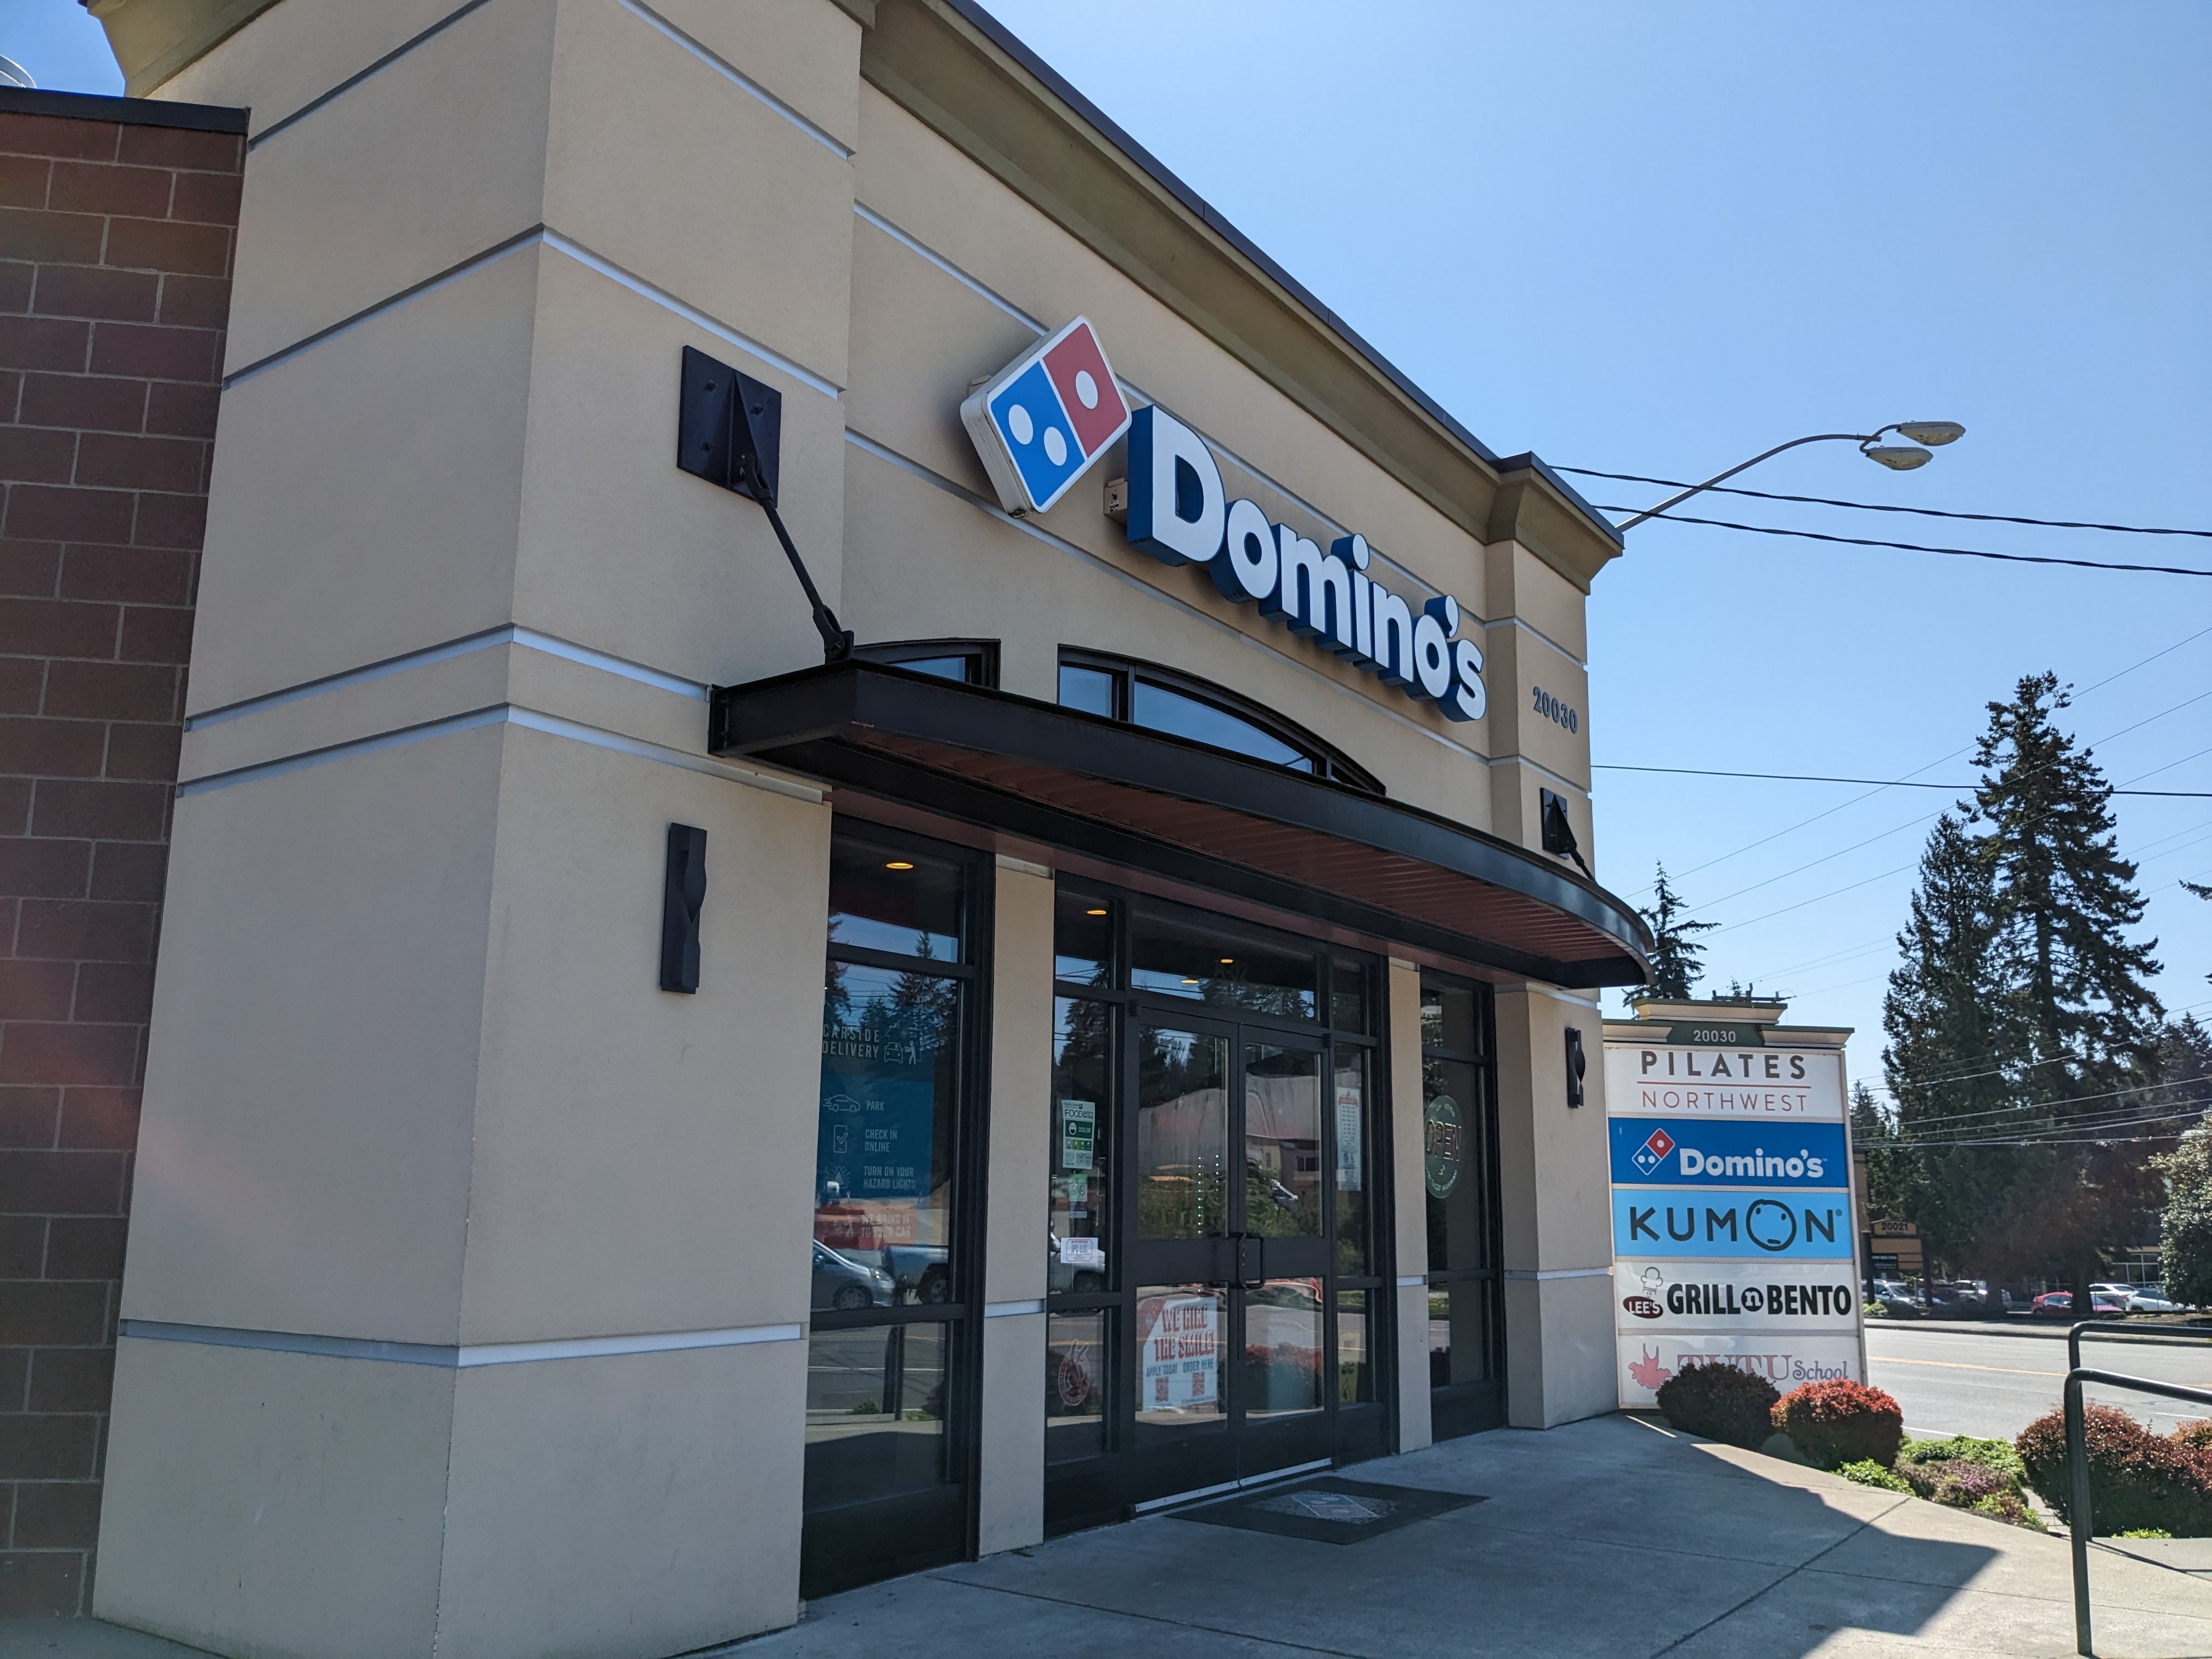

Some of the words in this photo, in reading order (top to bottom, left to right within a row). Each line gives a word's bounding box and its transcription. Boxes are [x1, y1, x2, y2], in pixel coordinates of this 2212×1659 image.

[1127, 404, 1486, 722] Domino's
[1533, 686, 1578, 734] 20030
[823, 1024, 879, 1042] CARSIDE
[1693, 1029, 1736, 1043] 20030
[822, 1040, 879, 1058] DELIVERY
[1640, 1050, 1805, 1080] PILATES
[866, 1100, 885, 1111] PARK
[1642, 1090, 1807, 1111] NORTHWEST
[1065, 1109, 1083, 1118] FOOD
[865, 1128, 888, 1139] CHECK
[890, 1130, 898, 1140] IN
[1426, 1119, 1462, 1161] OPEN
[865, 1141, 890, 1152] ONLINE
[864, 1165, 882, 1176] TURN
[884, 1166, 894, 1176] ON
[896, 1166, 914, 1177] YOUR
[1679, 1148, 1824, 1178] Domino's
[863, 1178, 890, 1189] HAZARD
[893, 1178, 916, 1189] LIGHTS
[1882, 1222, 1909, 1231] 20021
[1628, 1300, 1661, 1315] LEE'S
[1667, 1284, 1741, 1315] GRILL
[1743, 1289, 1762, 1308] n
[1767, 1285, 1852, 1316] BENTO
[1162, 1308, 1180, 1333] WE
[1183, 1305, 1208, 1331] HIRE
[1154, 1336, 1176, 1361] THE
[1146, 1365, 1162, 1377] APPLY
[1163, 1363, 1178, 1375] TODAY
[1182, 1360, 1200, 1373] ORDER
[1201, 1358, 1214, 1370] HERE
[1792, 1360, 1849, 1381] School
